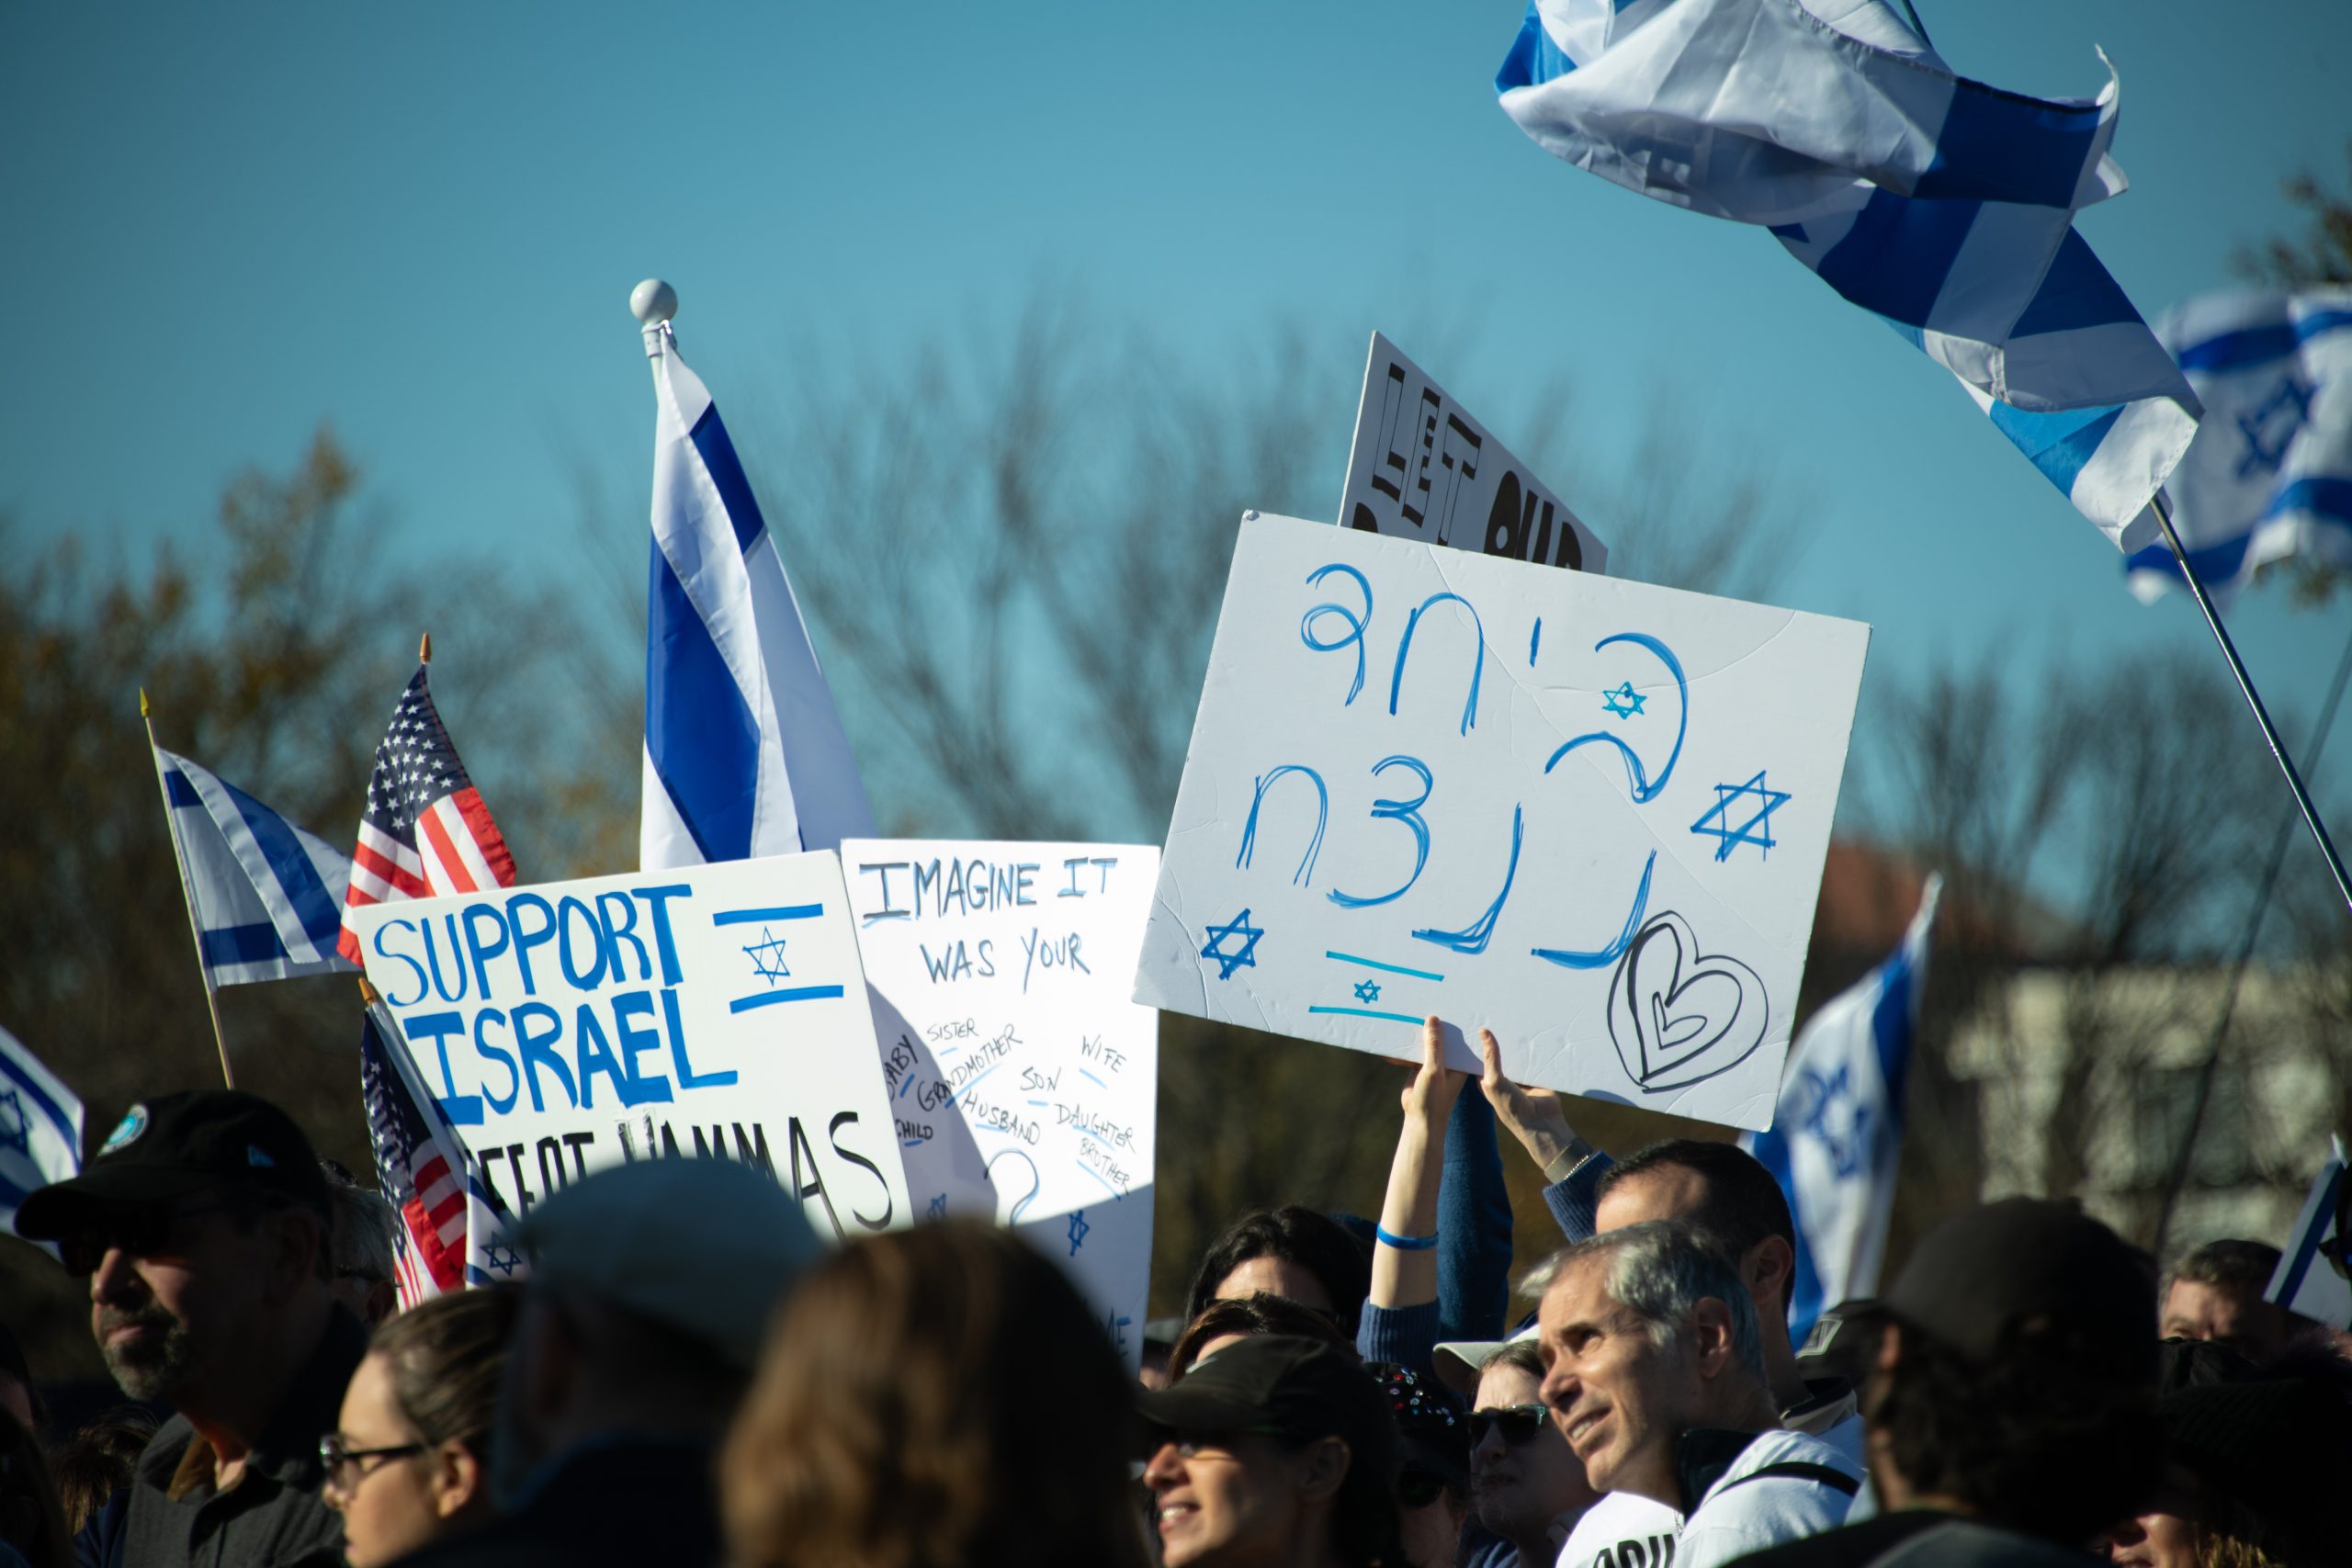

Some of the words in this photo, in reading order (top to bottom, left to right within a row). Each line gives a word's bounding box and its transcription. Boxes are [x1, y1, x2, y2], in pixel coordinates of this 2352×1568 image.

[1371, 362, 1482, 546] LET
[1300, 563, 1688, 804] ביחד
[859, 856, 1040, 928] IMAGINE
[1057, 857, 1118, 897] IT
[1237, 755, 1657, 970] ננצח
[374, 884, 693, 1007] SUPPORT
[920, 939, 995, 984] WAS
[1021, 927, 1091, 994] YOUR
[403, 989, 738, 1125] ISRAEL
[927, 1018, 978, 1042] SISTER
[1081, 1034, 1126, 1073] WIFE
[917, 1024, 1023, 1112] GRANDMOTHER
[1020, 1066, 1061, 1092] SON
[961, 1089, 1041, 1146] HUSBAND
[1054, 1102, 1136, 1154] DAUGHTER
[1080, 1137, 1130, 1196] BROTHER
